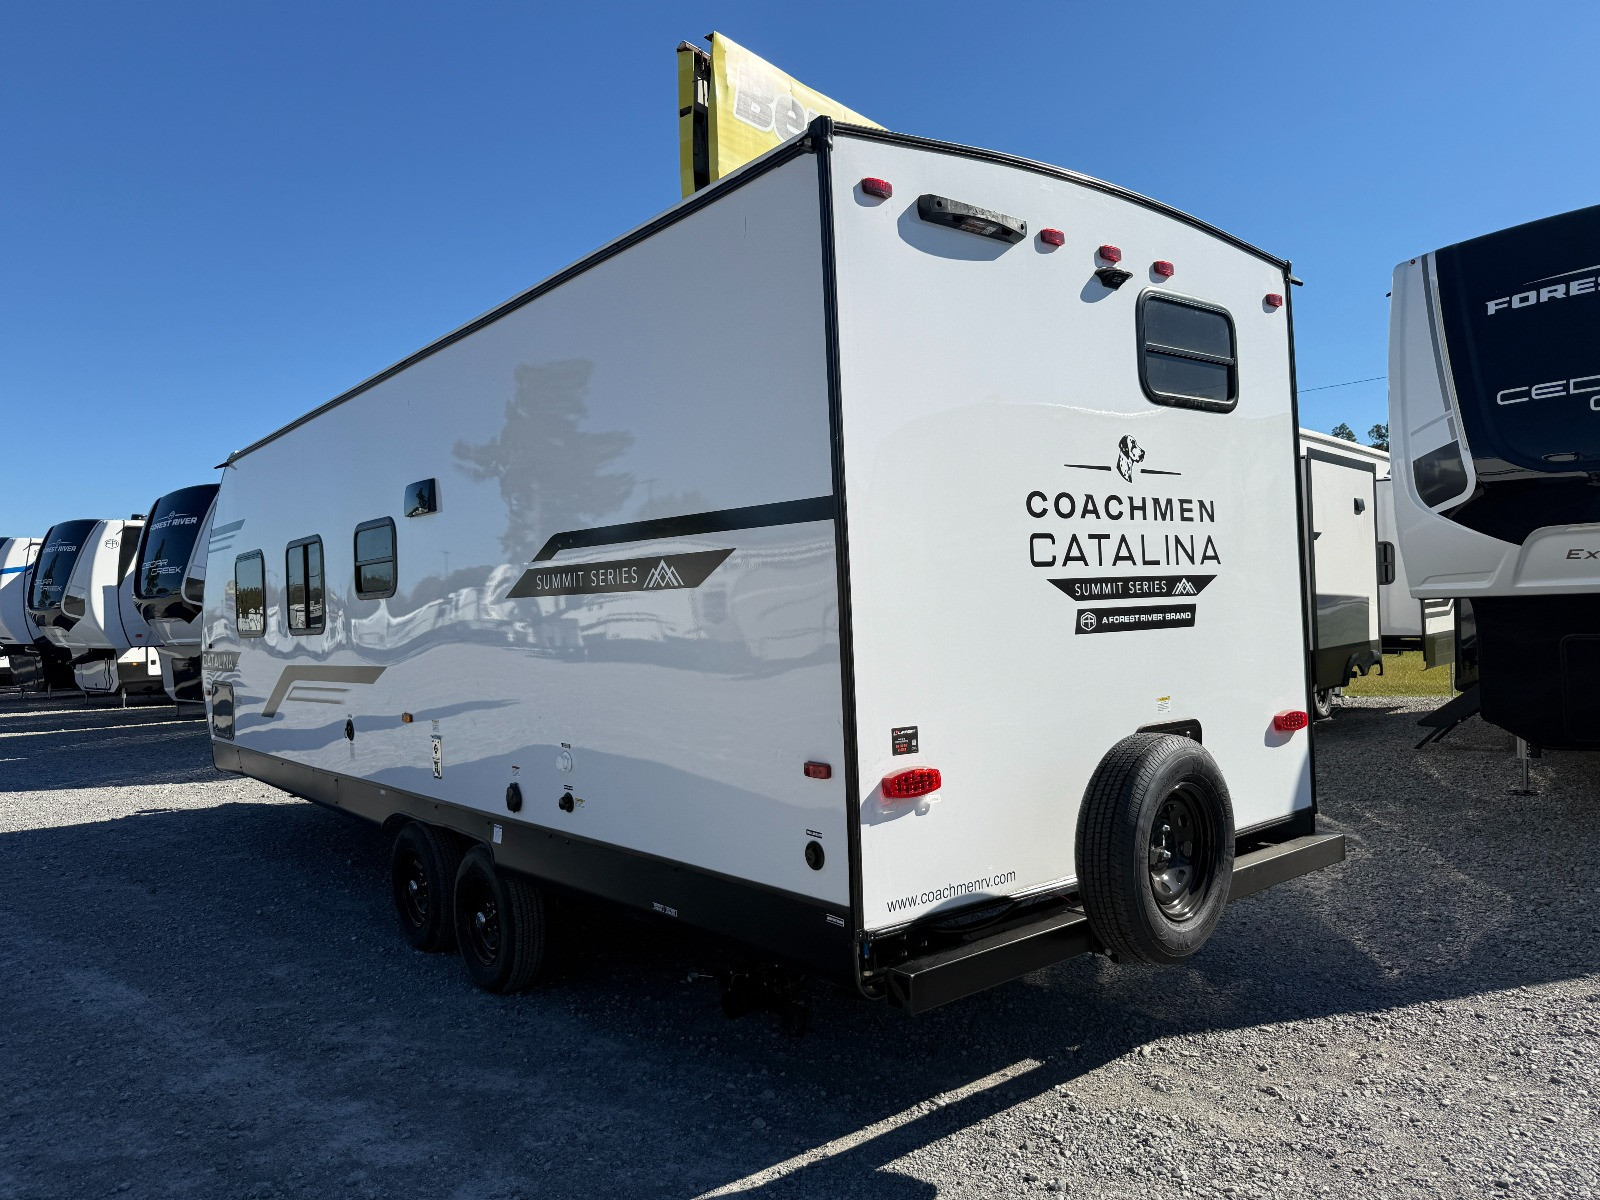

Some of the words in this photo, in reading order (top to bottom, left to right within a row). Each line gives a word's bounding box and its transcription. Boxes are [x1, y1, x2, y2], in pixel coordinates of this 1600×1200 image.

[733, 65, 818, 143] Be
[1485, 276, 1600, 316] FORE
[1026, 490, 1215, 523] COACHMEN
[172, 516, 198, 526] RIVER
[1029, 532, 1222, 567] CATALINA
[151, 565, 183, 576] CREEK
[536, 571, 584, 590] SUMMIT
[590, 566, 638, 587] SERIES
[1074, 582, 1124, 596] SUMMIT
[1128, 580, 1167, 594] SERIES
[1101, 616, 1109, 624] A
[1109, 615, 1139, 624] FOREST
[1165, 611, 1192, 620] BRAND
[202, 653, 234, 670] CATALINA
[886, 869, 1016, 913] www.coachmenrv.com
